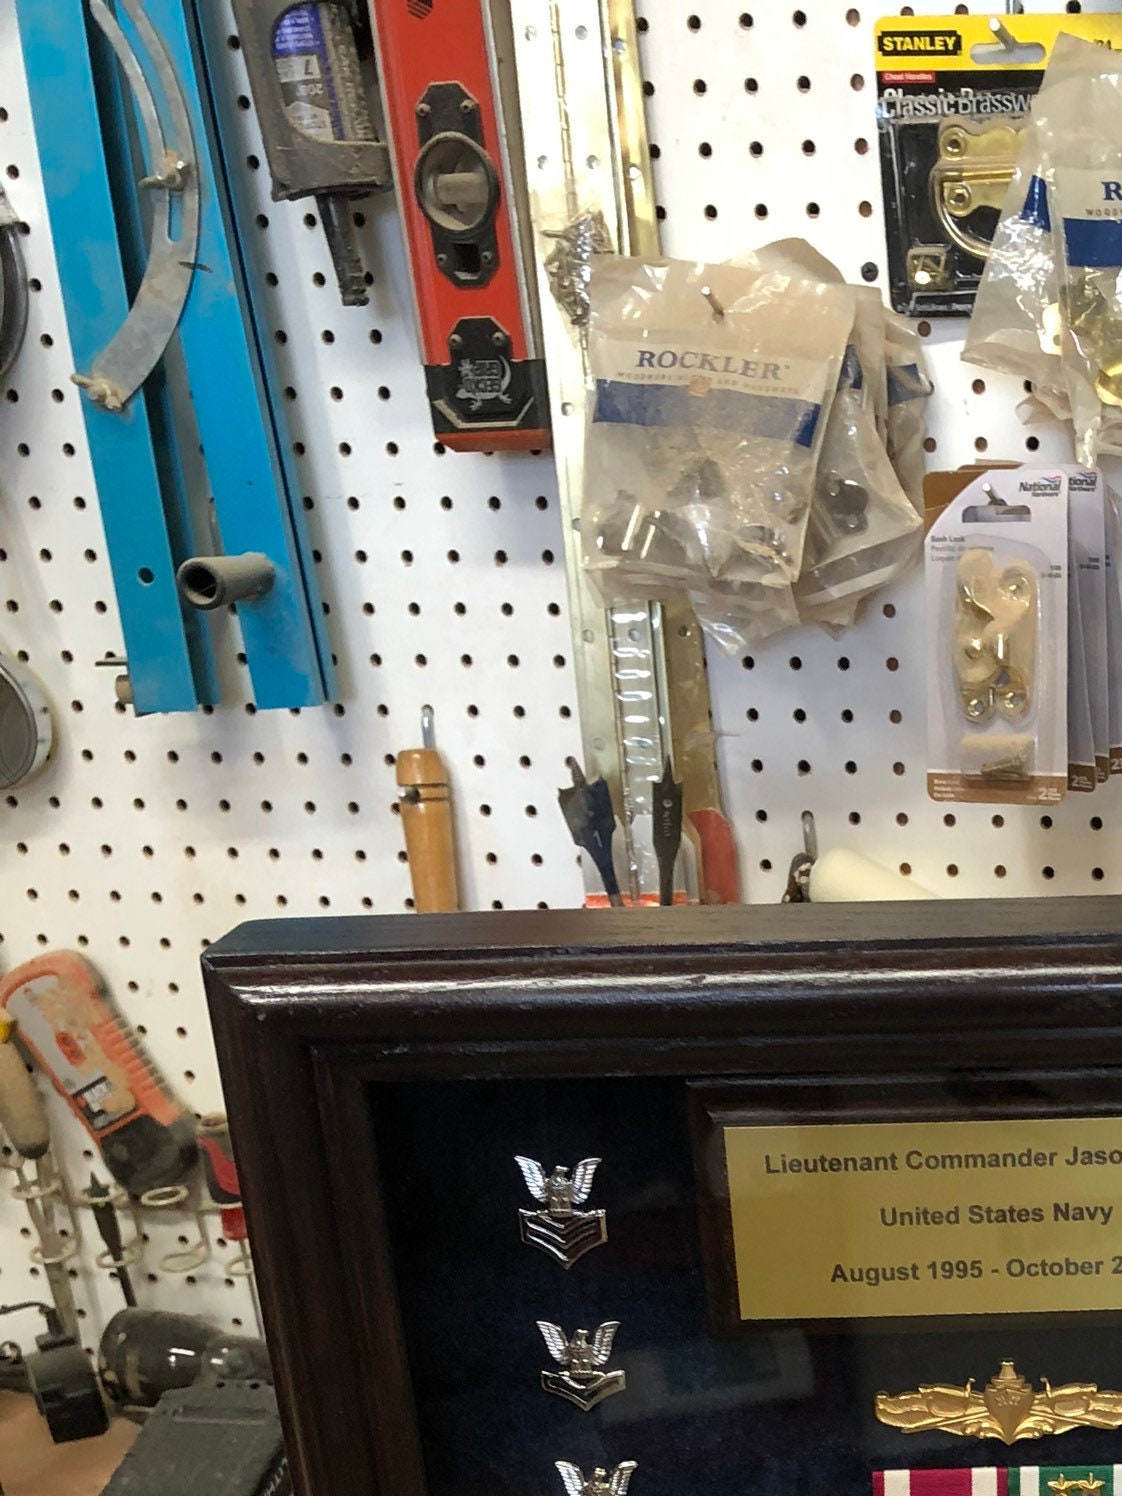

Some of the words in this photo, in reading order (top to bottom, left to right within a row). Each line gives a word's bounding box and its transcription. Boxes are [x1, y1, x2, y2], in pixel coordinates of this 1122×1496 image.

[882, 36, 957, 51] STANLEY
[635, 349, 783, 381] ROCKLER
[1019, 479, 1062, 493] National
[1069, 476, 1097, 487] tional
[764, 1152, 899, 1175] Lieutenant
[905, 1148, 1058, 1171] Commander
[880, 1205, 960, 1227] United
[967, 1204, 1045, 1225] States
[1053, 1202, 1114, 1226] Navy
[831, 1262, 920, 1287] August
[927, 1260, 983, 1280] 1995
[1006, 1257, 1104, 1278] October
